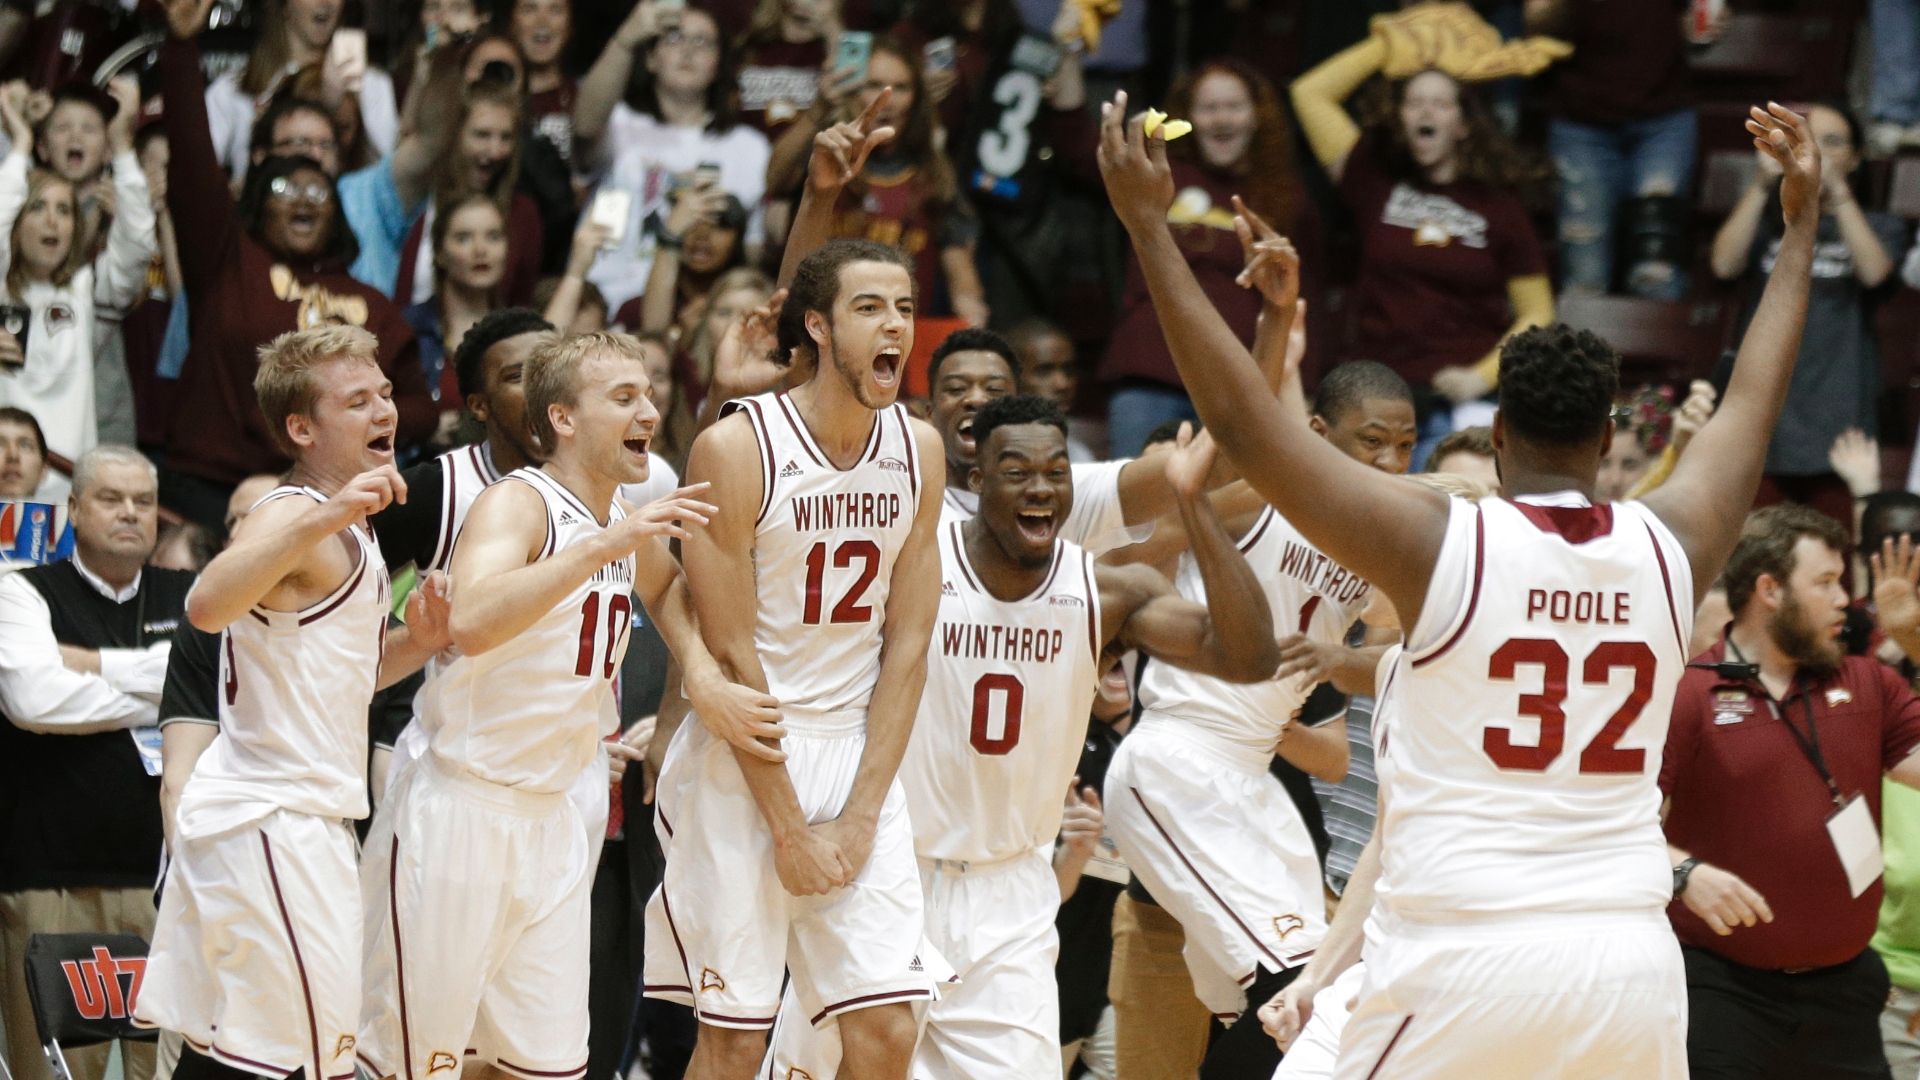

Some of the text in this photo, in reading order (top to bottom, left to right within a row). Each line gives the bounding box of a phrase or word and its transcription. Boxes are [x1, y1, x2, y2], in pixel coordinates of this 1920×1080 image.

[978, 69, 1041, 177] 3
[792, 492, 900, 532] WINTHROP
[803, 540, 881, 625] 12
[1279, 540, 1371, 606] WINTHROP
[1527, 588, 1631, 625] POOLE
[574, 591, 632, 680] 10
[943, 622, 1063, 663] WINTHROP
[969, 672, 1025, 757] 0
[1483, 637, 1658, 775] 32
